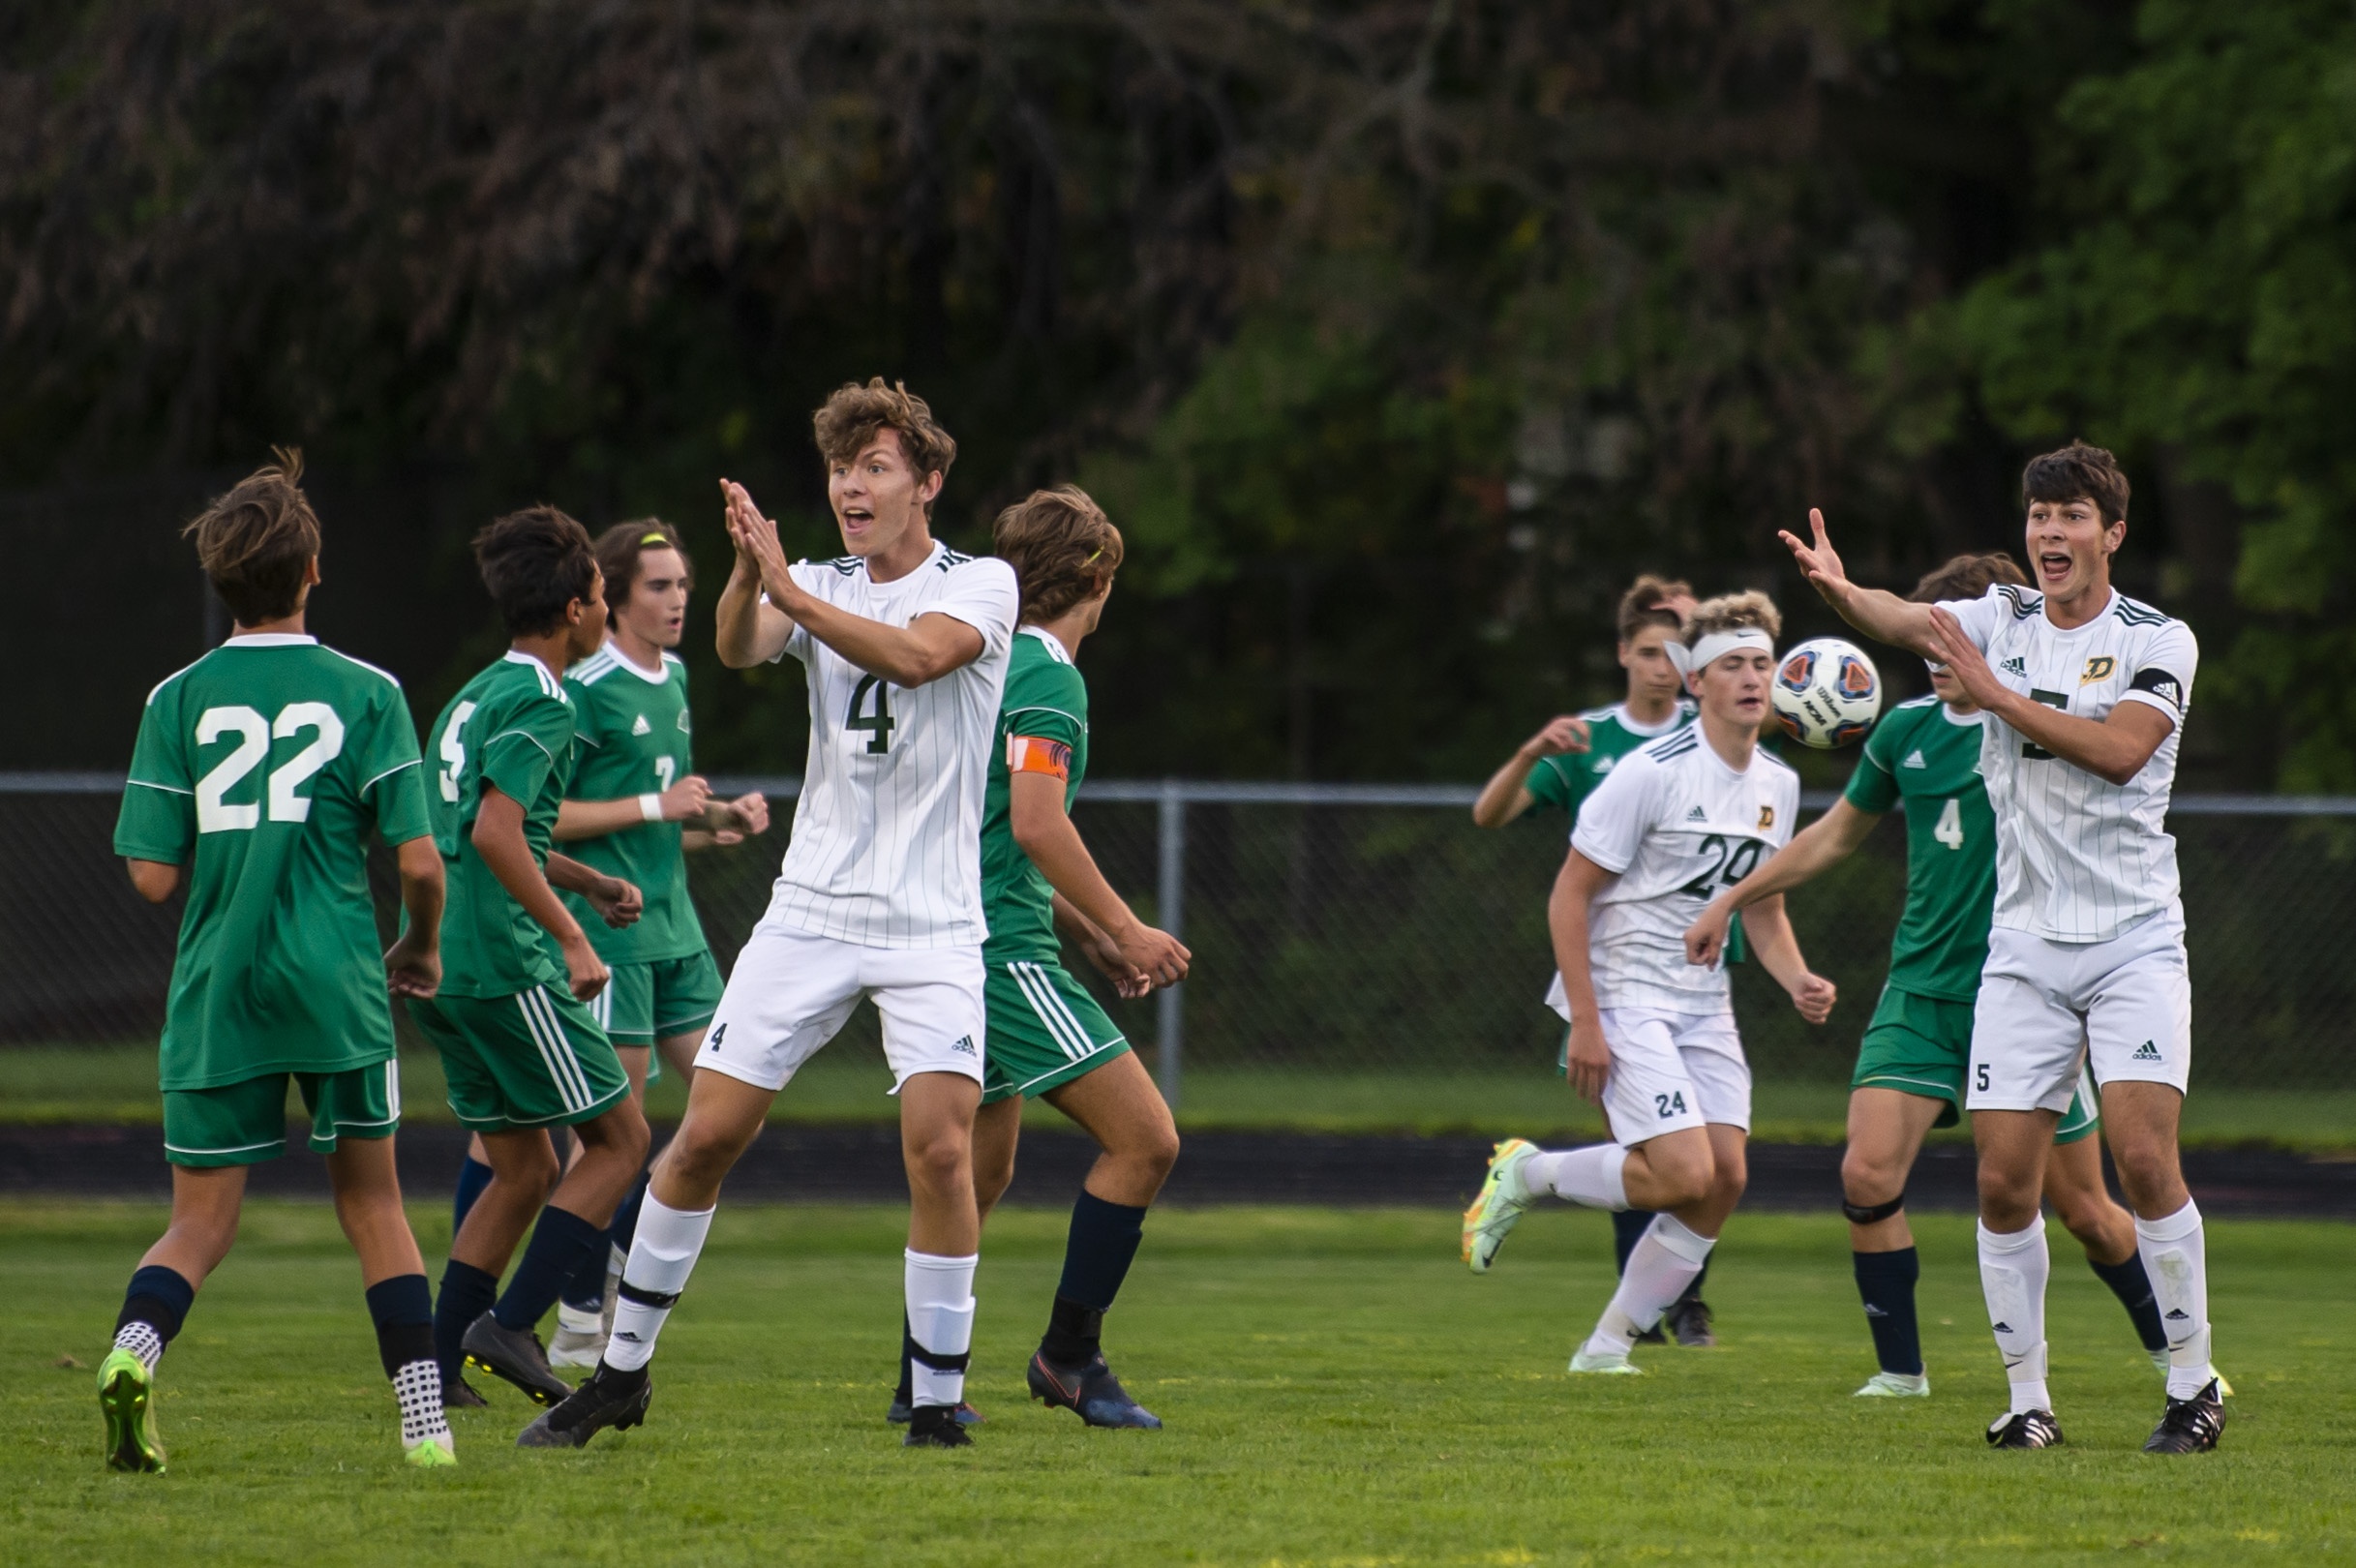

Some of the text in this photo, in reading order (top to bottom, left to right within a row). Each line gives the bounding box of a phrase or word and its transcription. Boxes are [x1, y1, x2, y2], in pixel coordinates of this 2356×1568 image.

[845, 672, 895, 755] 4
[195, 701, 346, 834] 22
[1933, 798, 1964, 850] 4
[710, 1022, 728, 1052] 4
[2131, 1052, 2162, 1061] adidas
[1977, 1064, 1990, 1092] 5
[1655, 1090, 1688, 1119] 24
